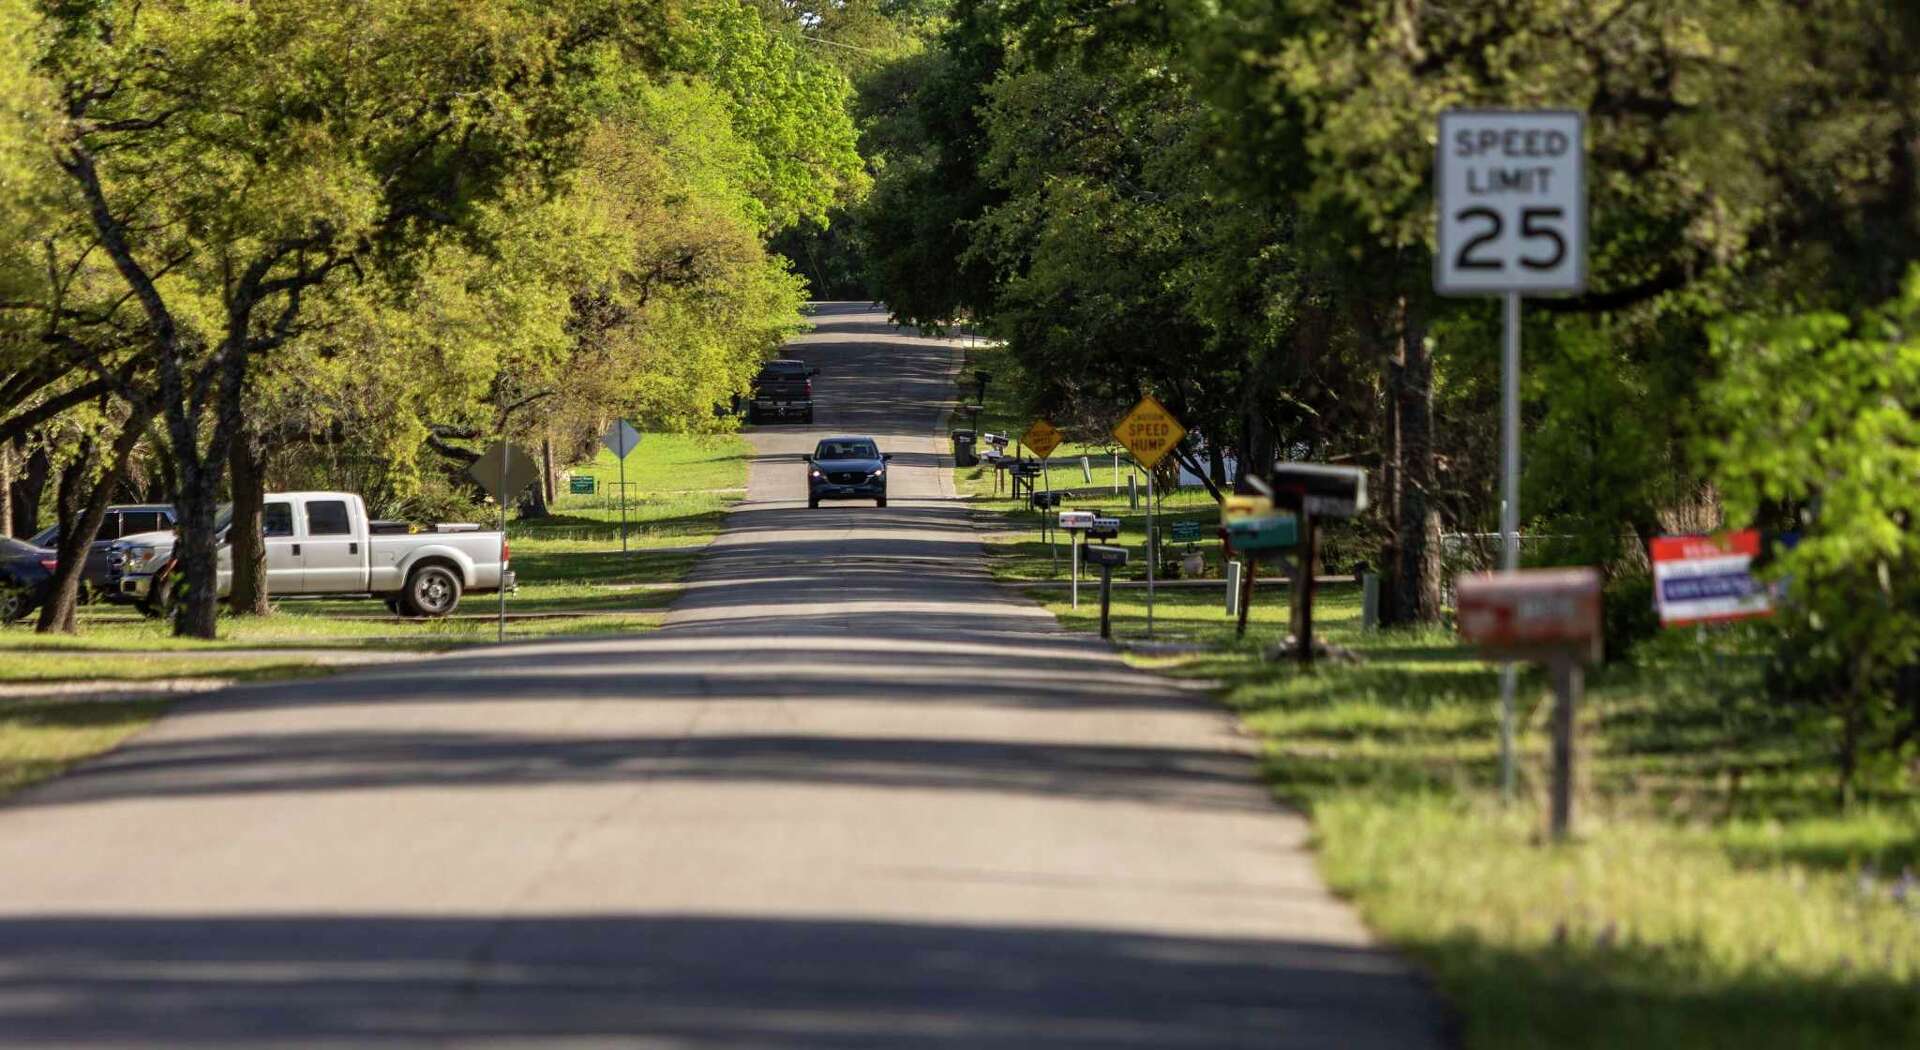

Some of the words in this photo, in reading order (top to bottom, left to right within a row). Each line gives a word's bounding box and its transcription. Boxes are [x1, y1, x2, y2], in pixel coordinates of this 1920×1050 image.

[1455, 128, 1569, 158] SPEED
[1466, 166, 1553, 195] LIMIT
[1455, 206, 1568, 272] 25
[1128, 423, 1169, 437] SPEED
[1130, 439, 1167, 451] HUMP
